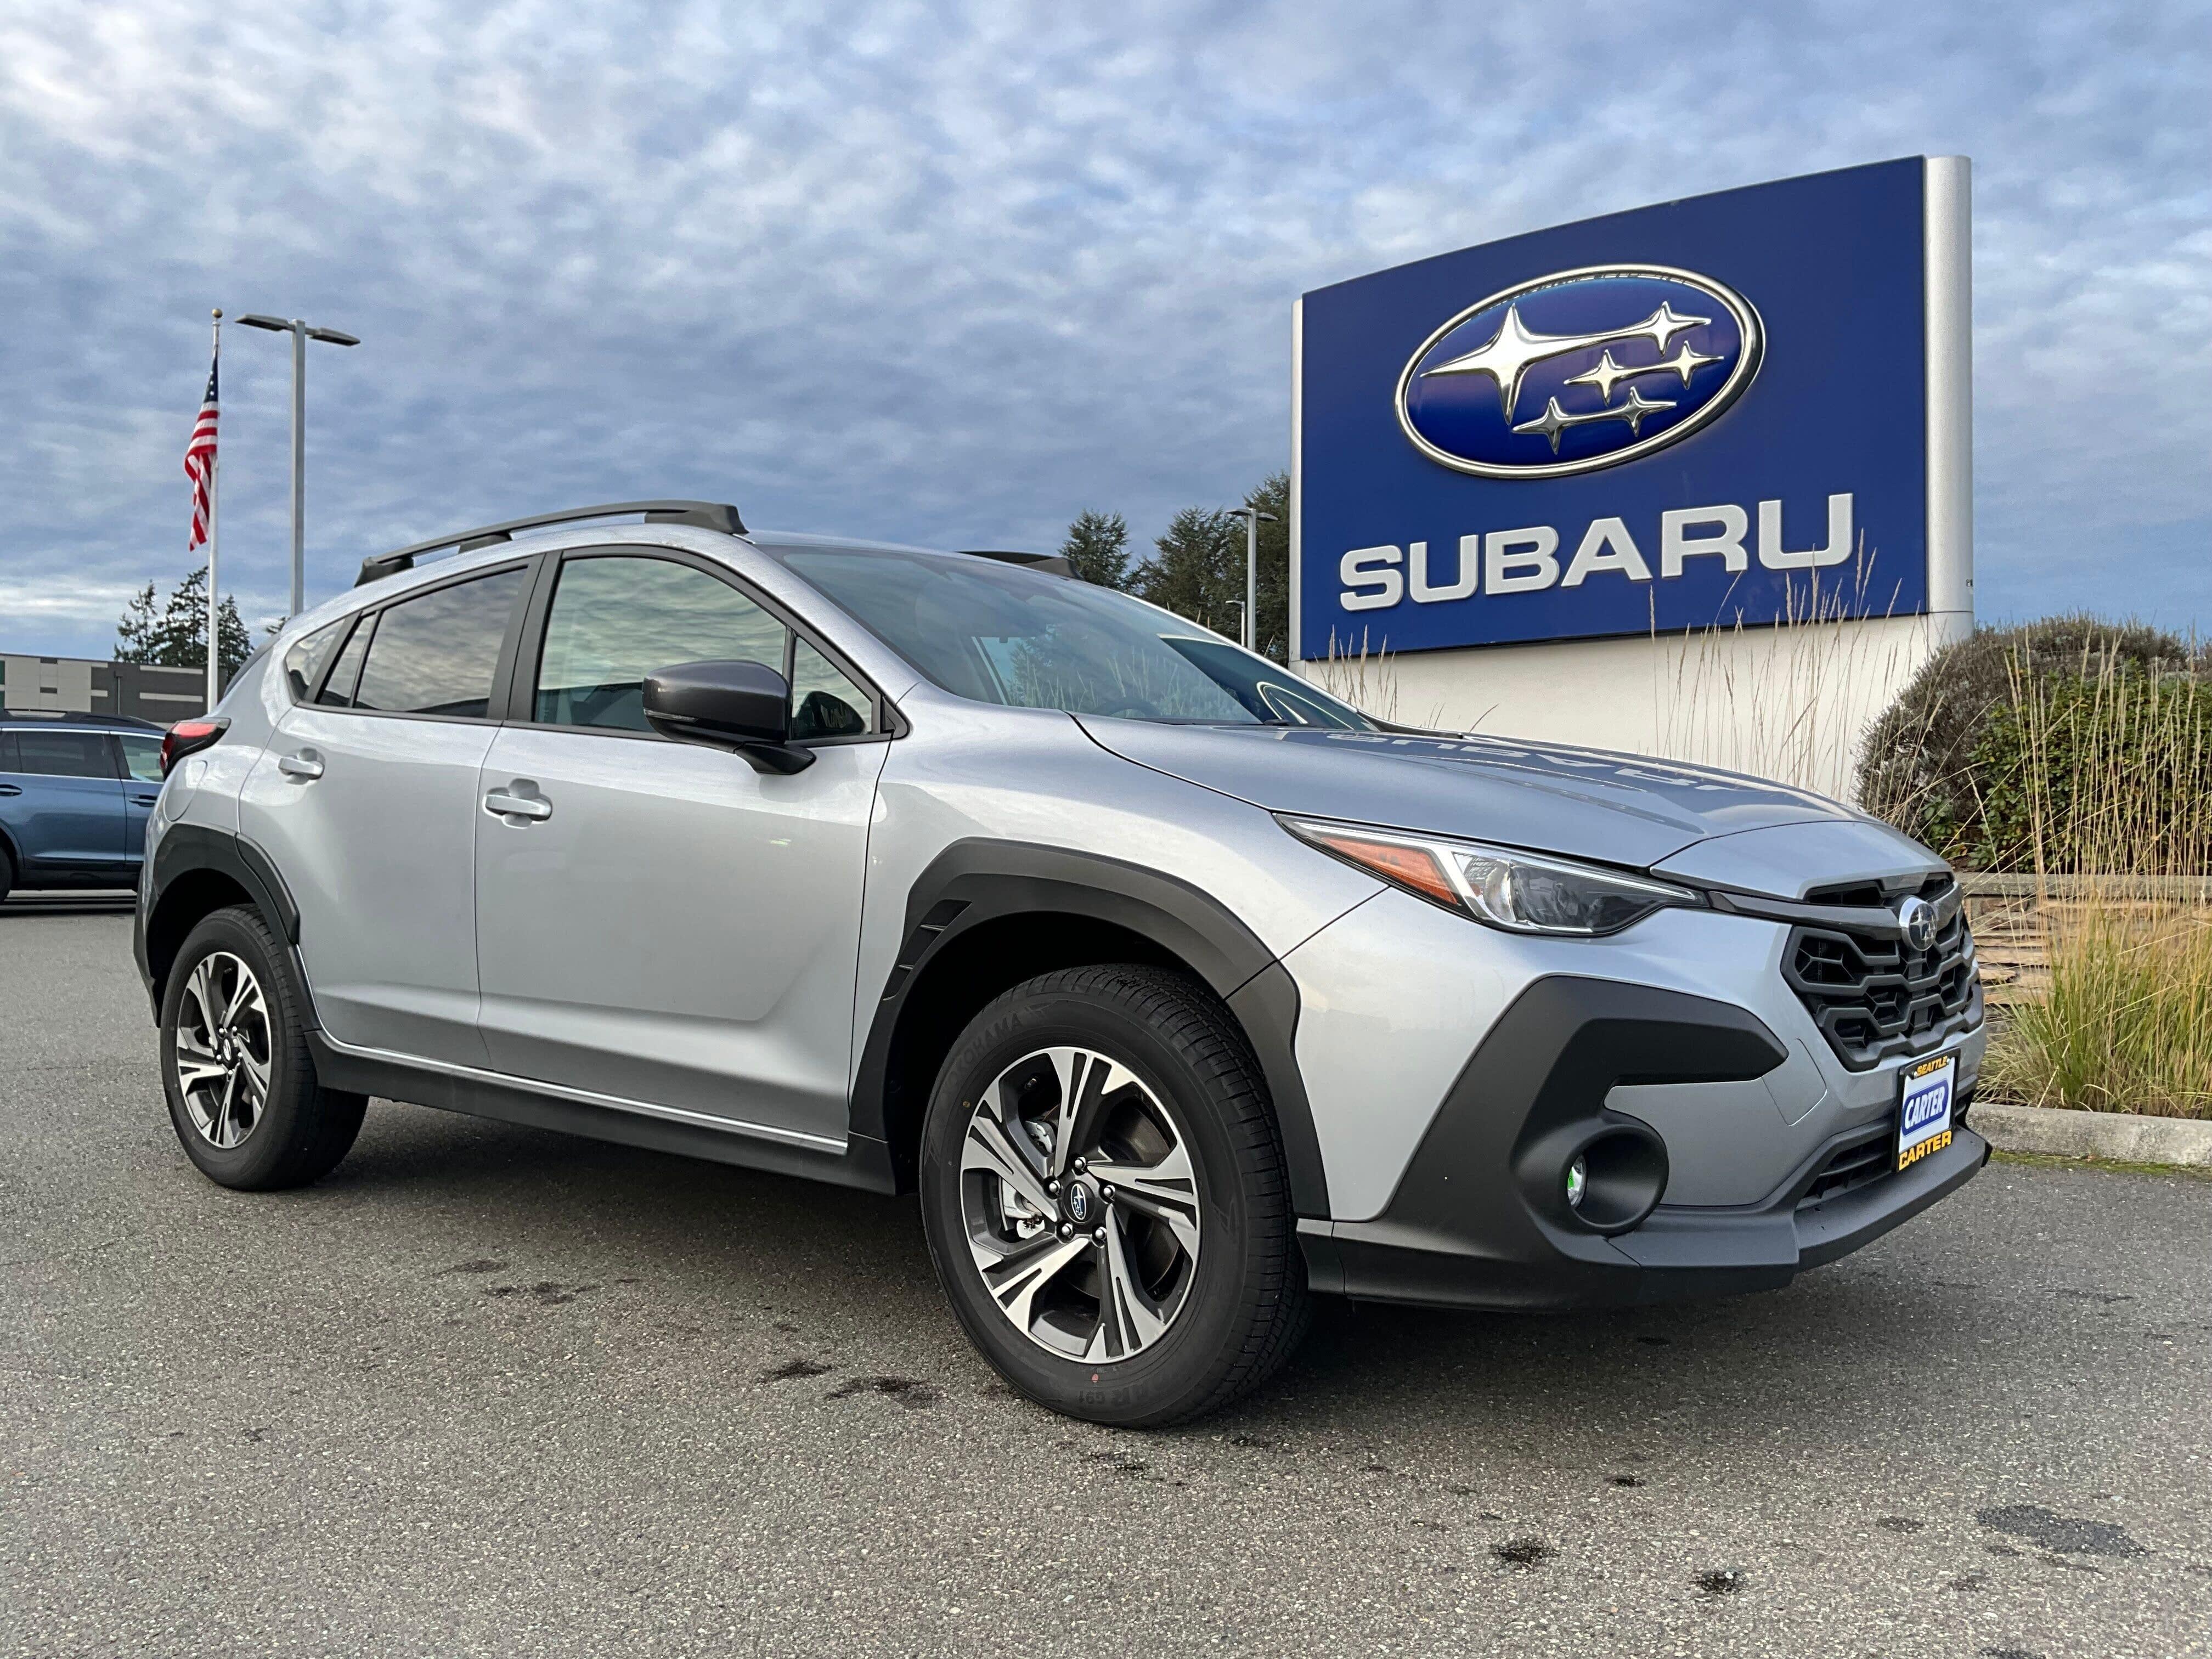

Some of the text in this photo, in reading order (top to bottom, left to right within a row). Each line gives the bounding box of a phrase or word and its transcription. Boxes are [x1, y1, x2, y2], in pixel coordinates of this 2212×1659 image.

[1340, 493, 1853, 611] SUBARU
[1917, 1056, 1948, 1076] SEATTLE
[1905, 1086, 1945, 1129] CARTER
[1899, 1130, 1952, 1171] CARTER
